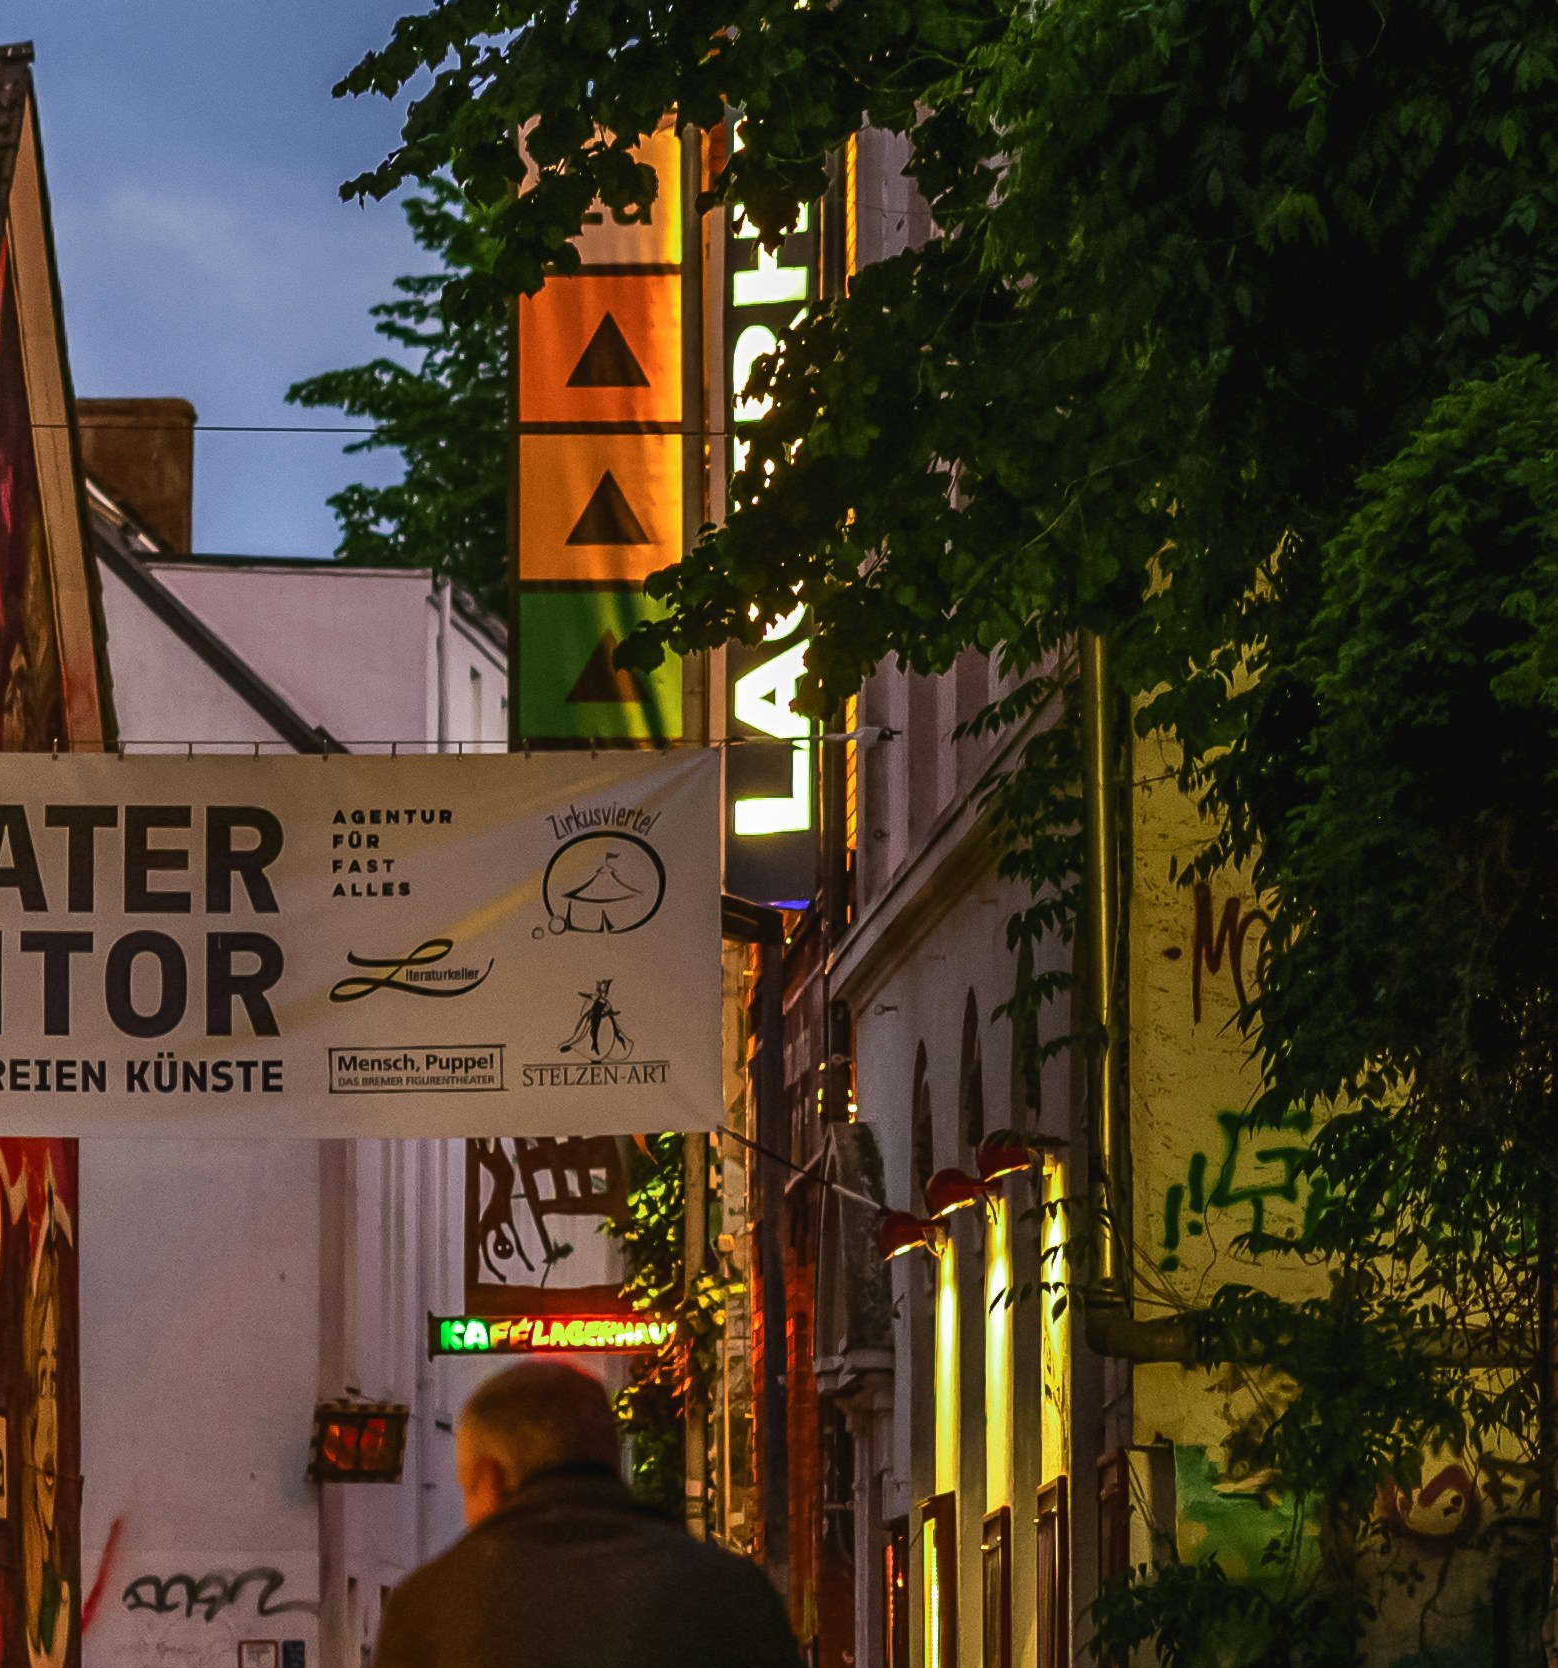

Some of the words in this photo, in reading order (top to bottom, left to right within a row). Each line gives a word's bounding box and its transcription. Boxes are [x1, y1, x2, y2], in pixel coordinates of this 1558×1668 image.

[332, 809, 453, 824] AGENTUR
[544, 803, 662, 841] Zirkusviertel
[332, 831, 380, 850] FÜR
[332, 859, 395, 874] FAST
[332, 882, 411, 897] ALLES
[126, 1052, 284, 1093] KÜNSTE
[338, 1054, 421, 1075] Mensch,
[338, 1077, 359, 1087] DAS
[362, 1076, 403, 1086] BREMER
[406, 1075, 494, 1086] FIGURENTHEATER
[522, 1065, 669, 1087] STELZEN-ART
